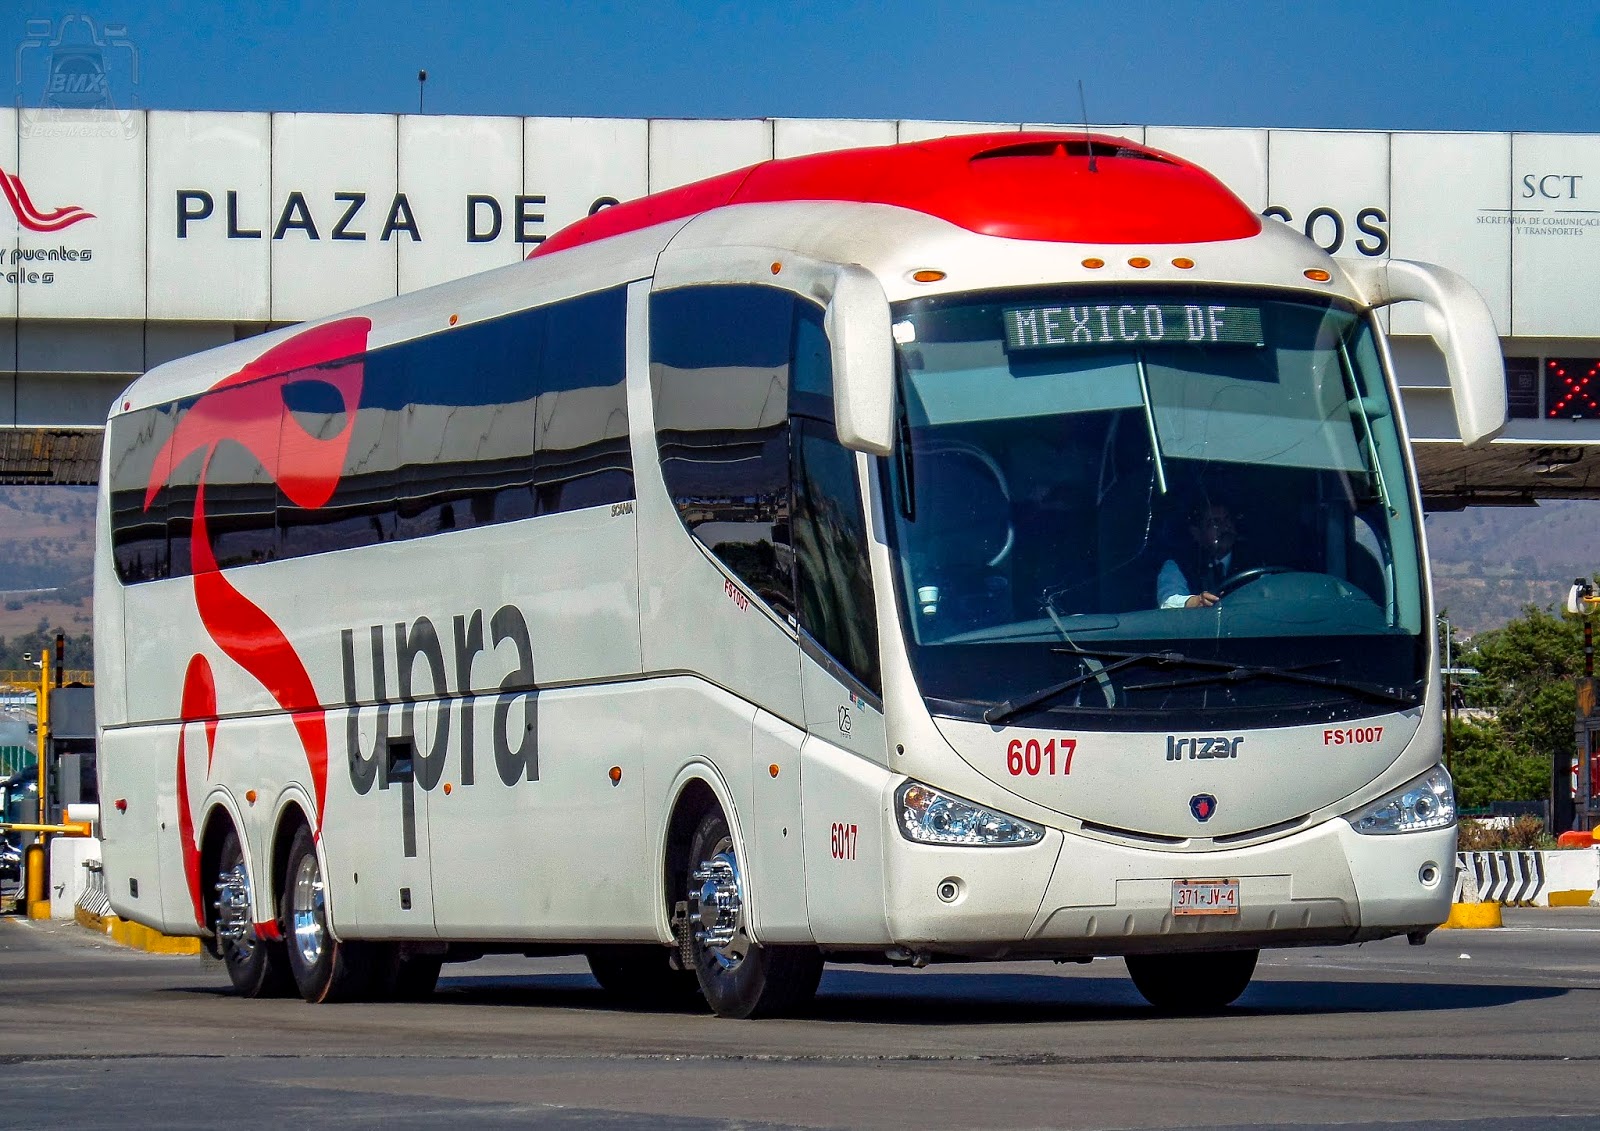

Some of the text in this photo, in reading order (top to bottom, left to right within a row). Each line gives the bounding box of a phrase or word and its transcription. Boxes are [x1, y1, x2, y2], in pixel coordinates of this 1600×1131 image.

[1522, 174, 1583, 199] SCT
[176, 189, 547, 243] PLAZA DE
[1529, 216, 1541, 226] DE
[1516, 226, 1583, 236] Y TRANSPORTES
[10, 245, 92, 265] puentes
[1015, 304, 1226, 346] MEXICO DF
[611, 501, 633, 517] SCANIA
[723, 578, 750, 612] FS1007
[1166, 735, 1244, 761] Irizar
[1324, 726, 1384, 746] FS1007
[1006, 738, 1077, 776] 6017
[831, 822, 858, 860] 6017
[1178, 888, 1235, 905] 371-JV-4
